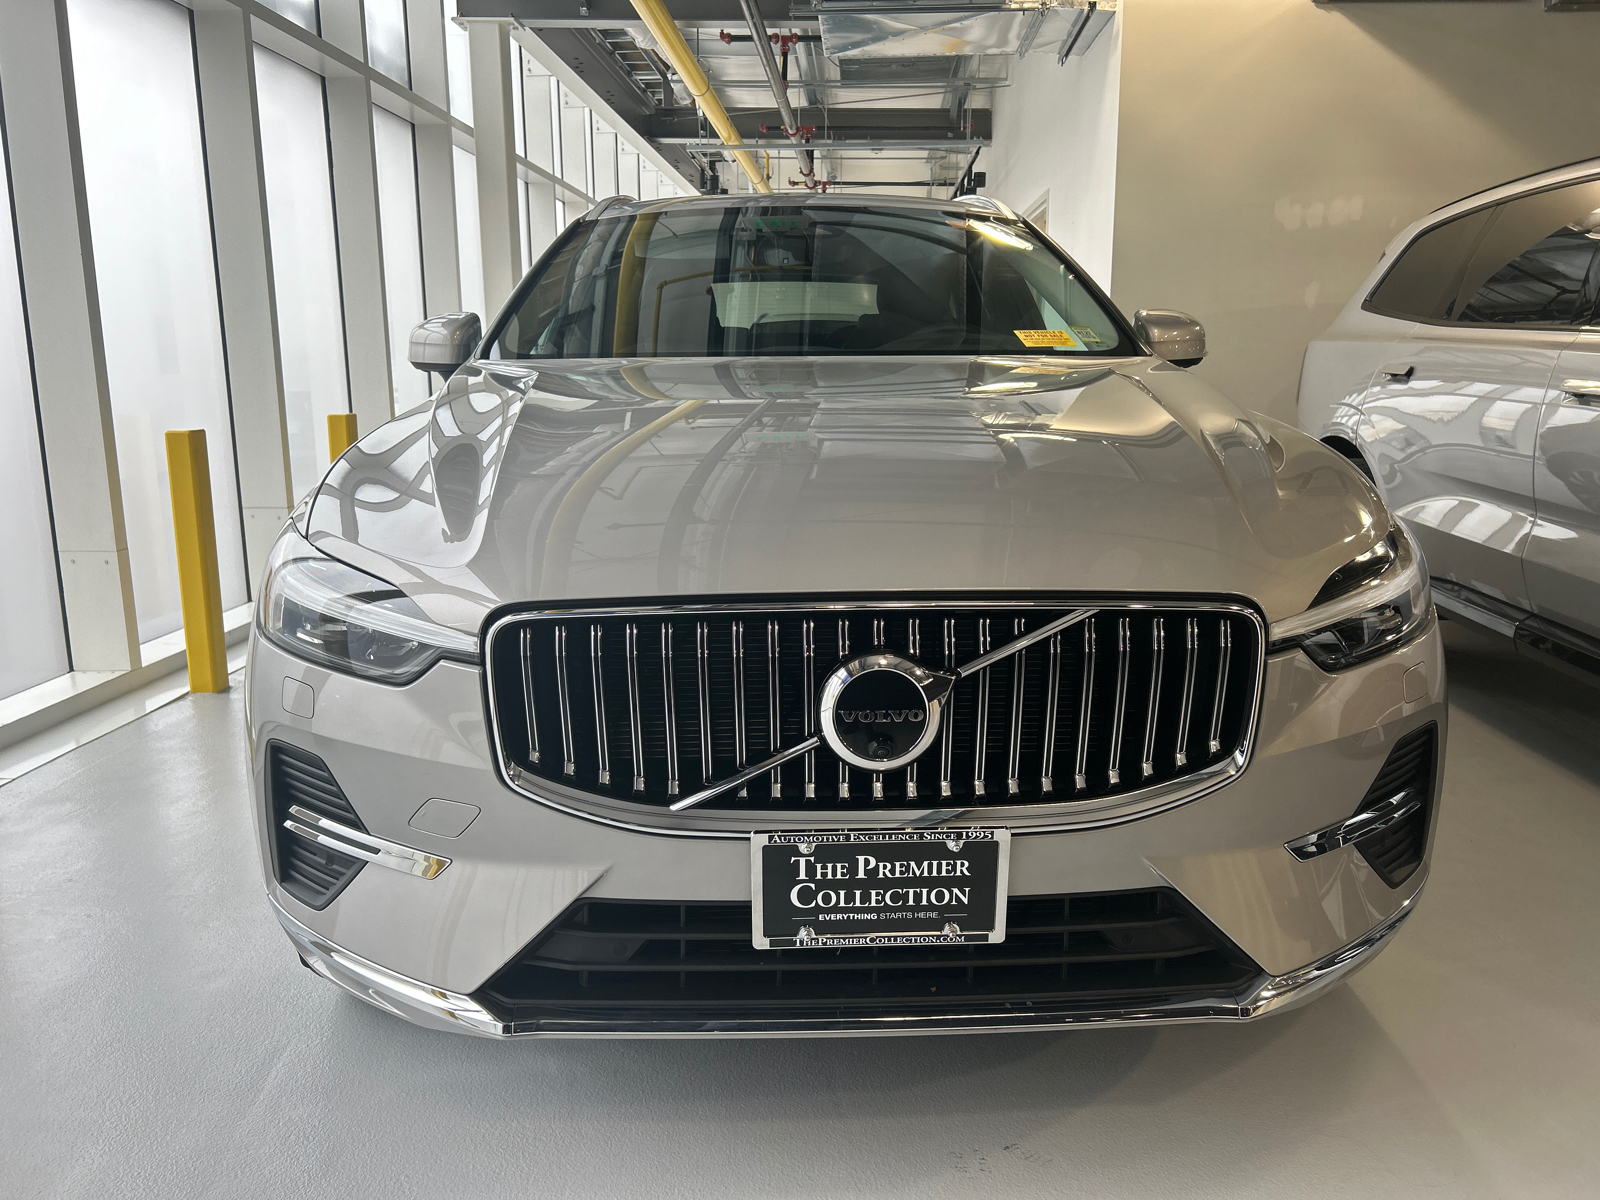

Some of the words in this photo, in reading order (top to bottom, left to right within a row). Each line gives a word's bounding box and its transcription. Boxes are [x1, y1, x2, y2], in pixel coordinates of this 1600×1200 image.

[838, 710, 924, 722] VOLVO
[770, 834, 846, 843] AUTOMOTIVE
[849, 833, 920, 842] EXCELLENCE
[923, 831, 957, 840] SINCE
[961, 831, 992, 840] 1995
[790, 856, 849, 880] THE
[855, 855, 971, 879] PREMIER
[789, 883, 971, 908] COLLECTION
[818, 913, 878, 921] EVERYTHING
[914, 911, 941, 919] HERE.
